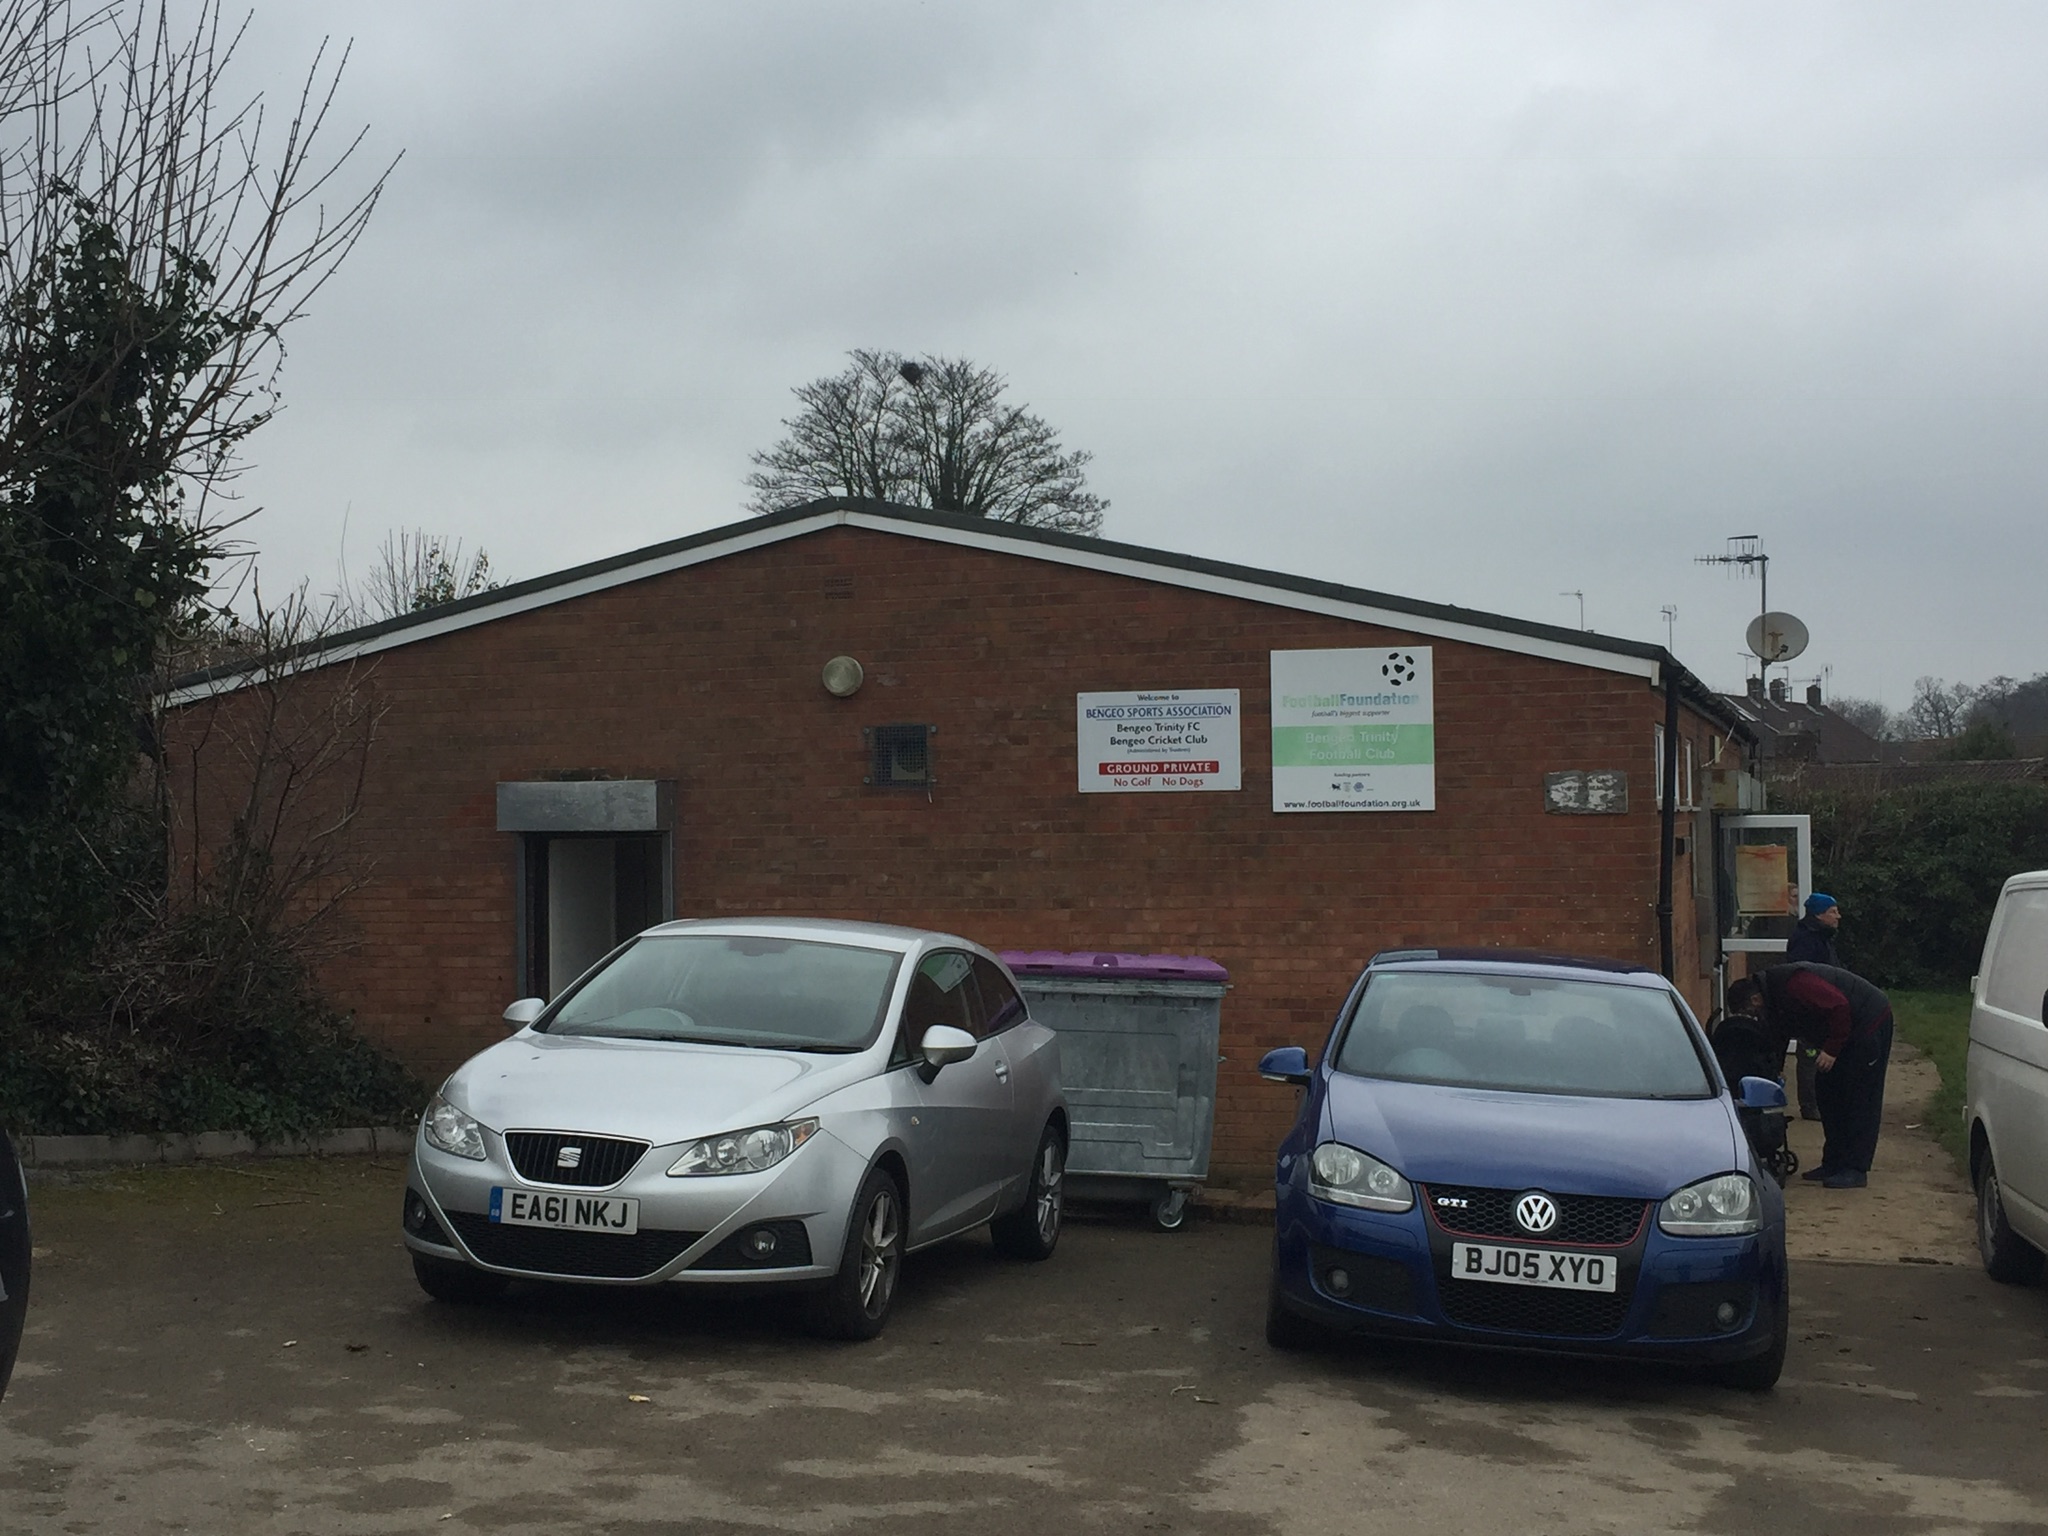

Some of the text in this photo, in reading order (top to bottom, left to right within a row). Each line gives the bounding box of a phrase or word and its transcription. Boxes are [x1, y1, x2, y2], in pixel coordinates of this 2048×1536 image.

[1086, 705, 1232, 718] BENGEO SPORTS ASSOCIATION
[1340, 710, 1361, 718] biggest
[1362, 710, 1390, 718] supporter
[1117, 722, 1200, 734] Bengeo Trinity FC
[1110, 735, 1208, 747] Bengeo Cricket Club
[1360, 731, 1398, 744] Trinity
[1310, 748, 1395, 760] Football Club
[1107, 762, 1211, 773] GROUND PRIVATE
[1114, 778, 1128, 787] No
[1162, 778, 1176, 786] No
[1180, 777, 1204, 788] Dogs
[1284, 800, 1420, 808] www.footballfoundation.org.uk
[1437, 1197, 1468, 1208] GTI
[510, 1193, 628, 1229] EA61 NKJ
[1465, 1247, 1604, 1284] BJ05 XYO
